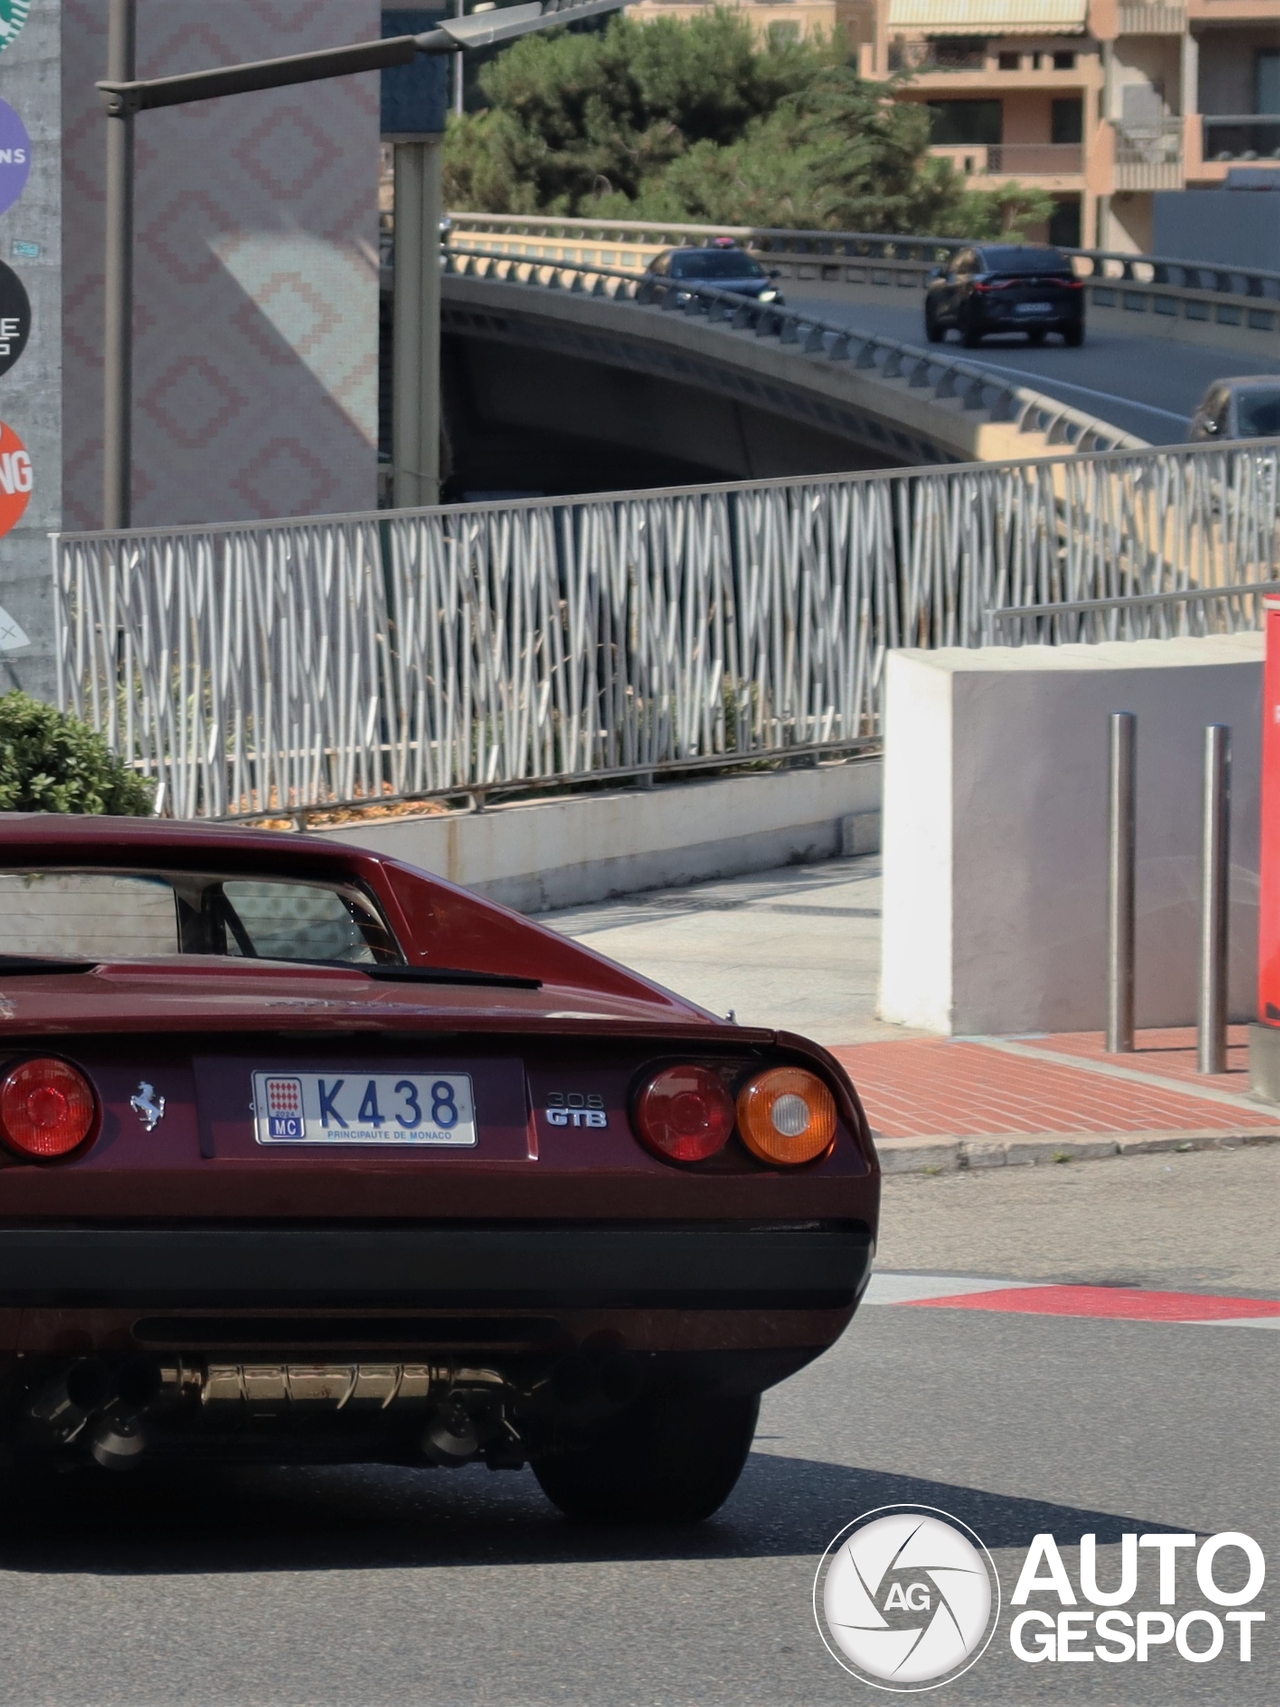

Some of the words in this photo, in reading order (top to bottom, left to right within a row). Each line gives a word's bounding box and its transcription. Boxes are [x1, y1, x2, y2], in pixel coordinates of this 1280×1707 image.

[318, 1079, 458, 1129] K438
[548, 1092, 604, 1109] 308
[546, 1108, 607, 1128] GTB
[275, 1119, 297, 1135] MC
[327, 1130, 390, 1139] PRINCIPAUTE
[394, 1131, 407, 1139] DE
[410, 1131, 452, 1140] MONACO
